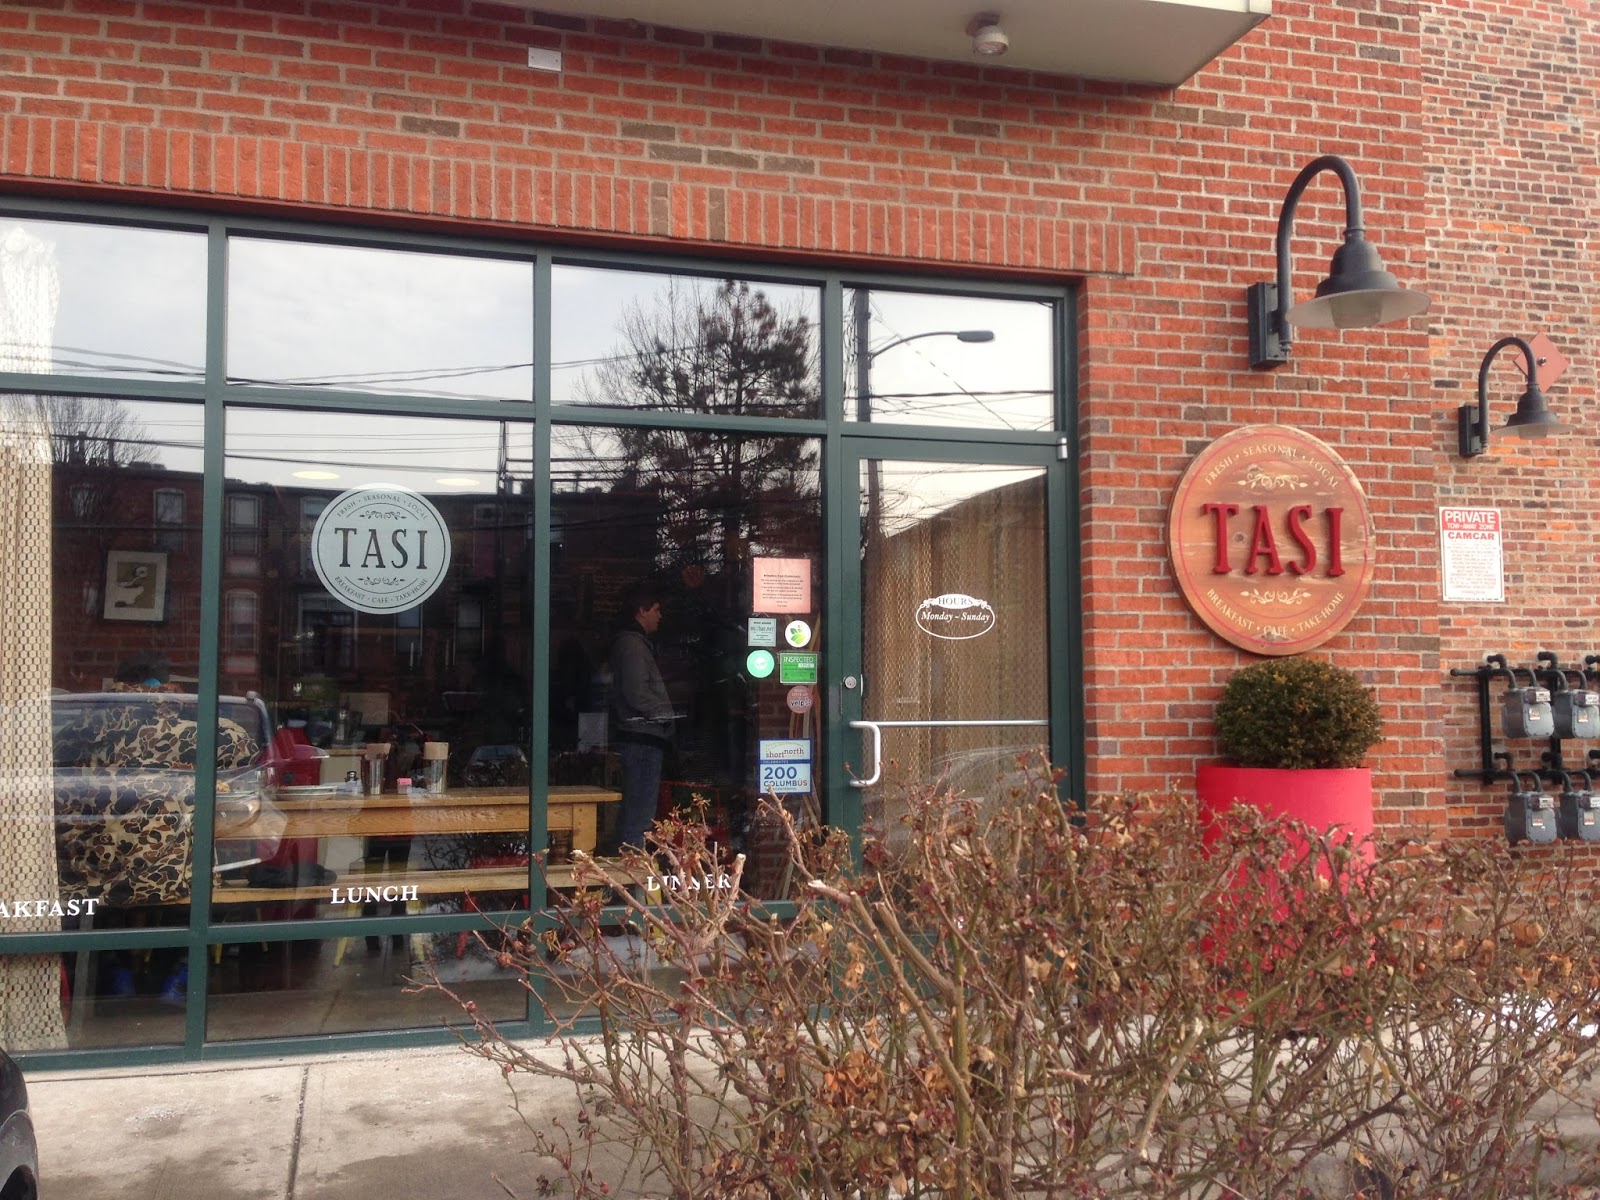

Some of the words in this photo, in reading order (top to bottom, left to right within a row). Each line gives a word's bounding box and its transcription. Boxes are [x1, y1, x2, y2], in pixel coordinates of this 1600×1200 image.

[1204, 456, 1233, 485] FRESH
[1242, 443, 1298, 458] SEASONAL
[1308, 457, 1340, 489] LOCAL
[336, 500, 356, 517] FRESH
[363, 493, 401, 503] SEASONAL
[407, 501, 428, 520] LOCAL
[1445, 511, 1495, 524] PRIVATE
[1202, 503, 1345, 577] TASI
[1448, 531, 1495, 540] CAMCAR
[334, 527, 427, 570] TASI
[334, 575, 366, 601] BREAKFAST
[395, 577, 428, 602] TAKE-HOME
[938, 597, 973, 606] HOURS
[1206, 588, 1255, 631] BREAKFAST
[1297, 590, 1345, 632] TAKE-HOME
[921, 611, 953, 623] Monday
[961, 611, 990, 623] Sunday
[790, 700, 805, 708] yelp
[764, 766, 797, 780] 200
[330, 885, 419, 904] LUNCH
